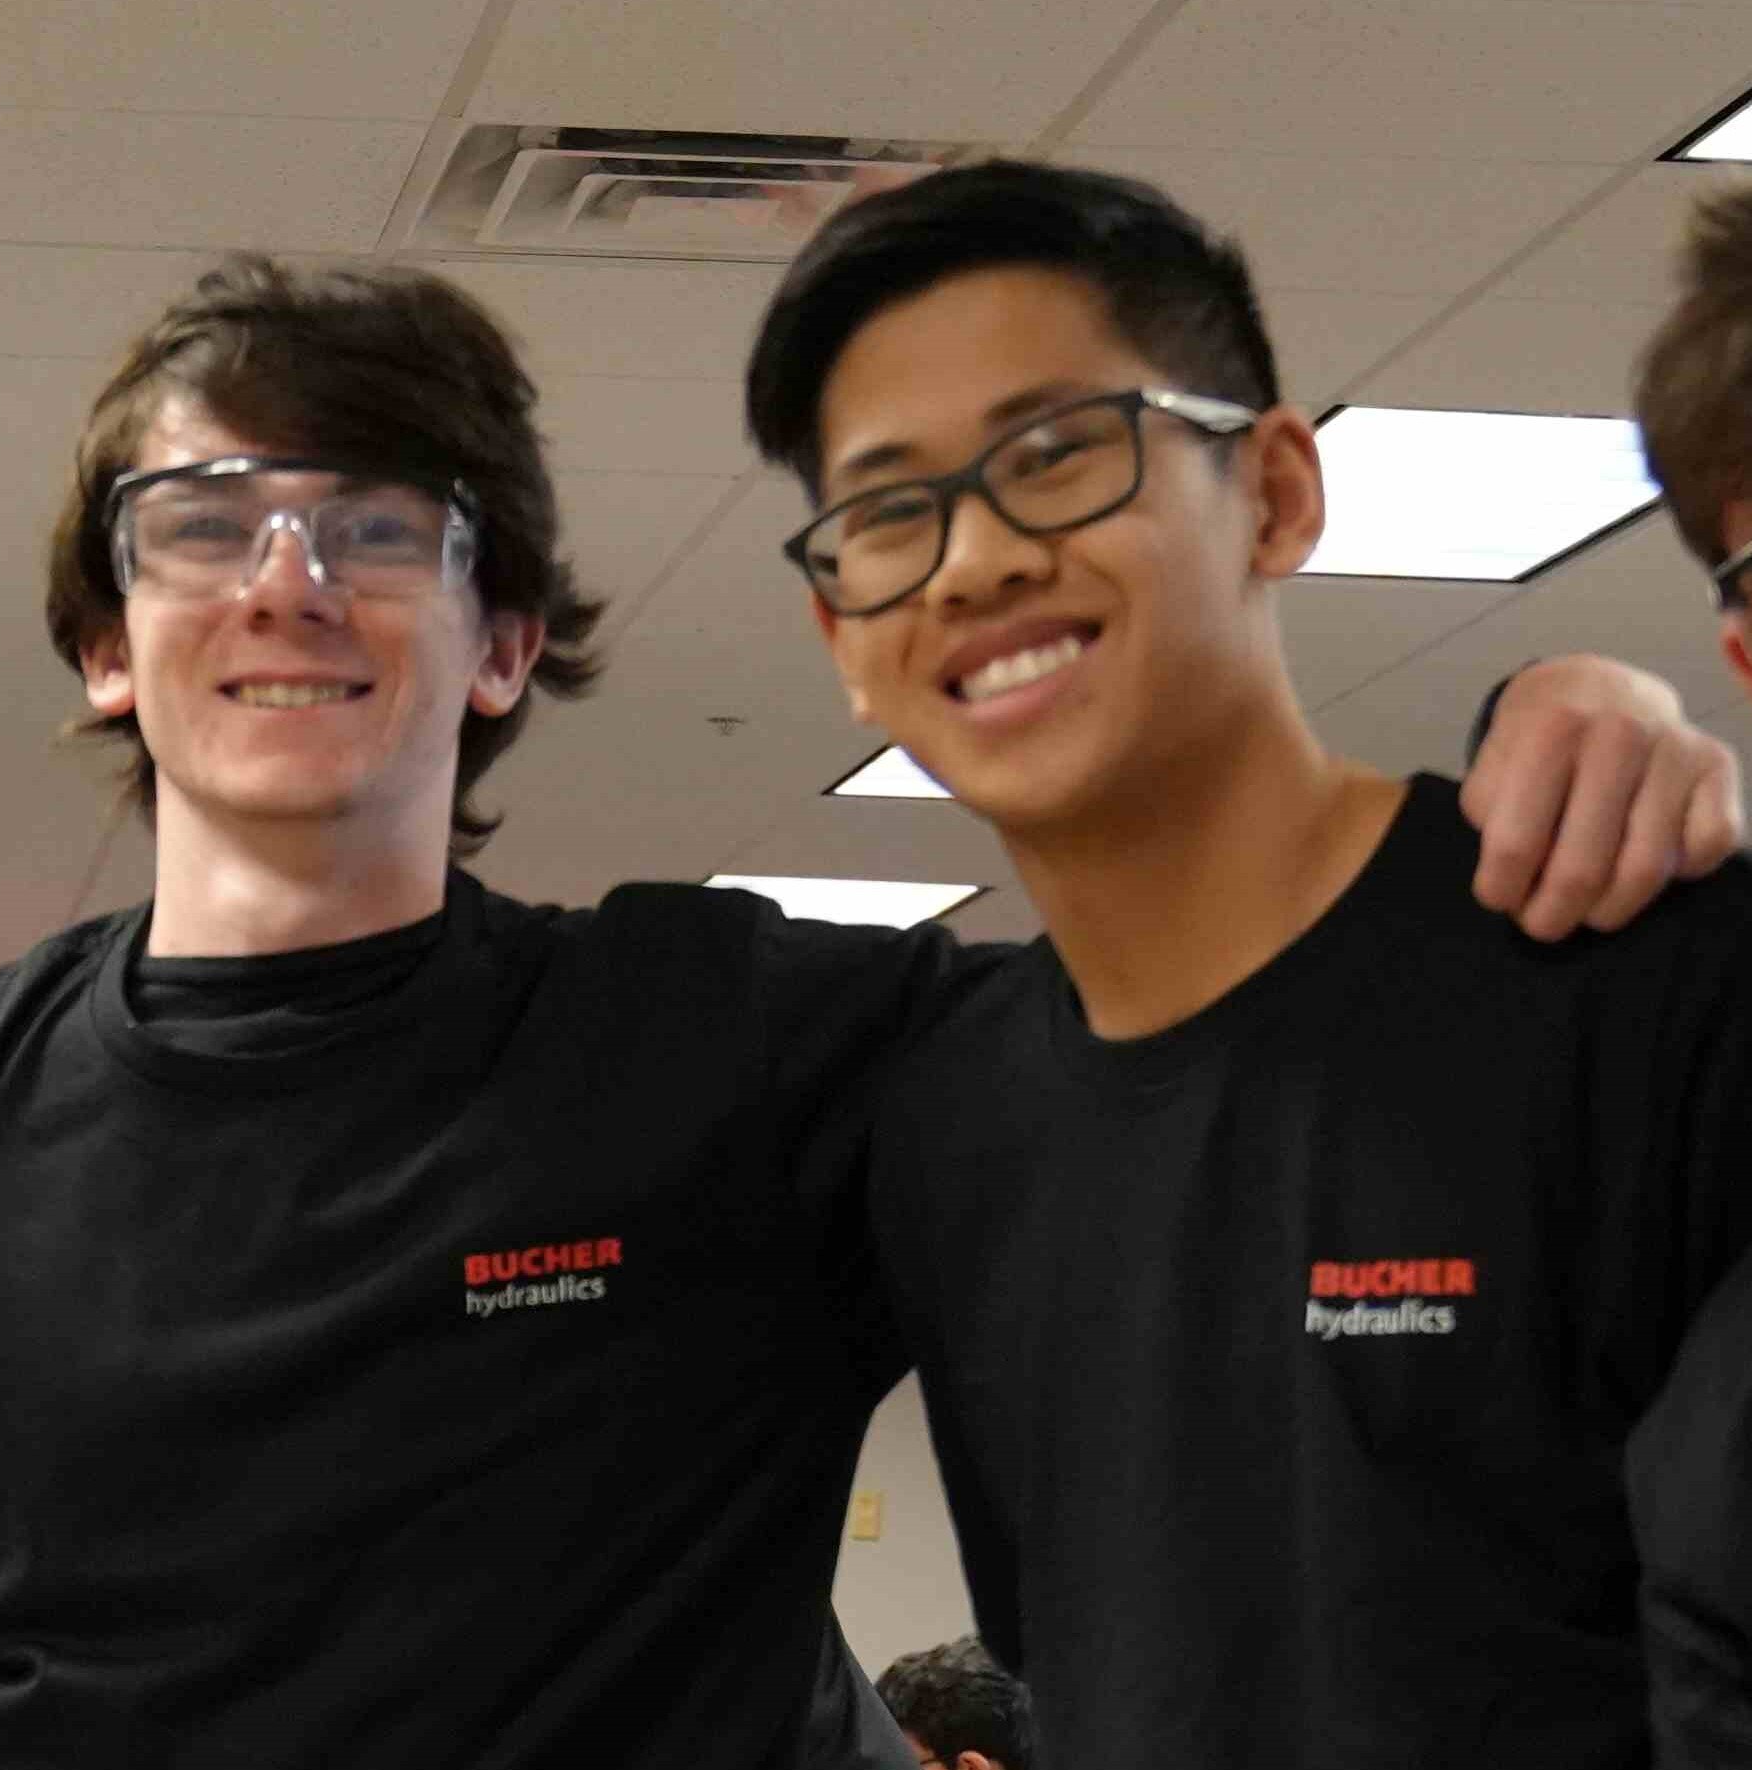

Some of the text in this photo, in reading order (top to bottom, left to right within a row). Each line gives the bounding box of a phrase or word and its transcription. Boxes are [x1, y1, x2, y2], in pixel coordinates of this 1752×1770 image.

[464, 1237, 622, 1287] BUCHER
[1311, 1258, 1475, 1298] BUCHER
[465, 1274, 607, 1318] hydraulics
[1305, 1298, 1457, 1341] hydraulics
